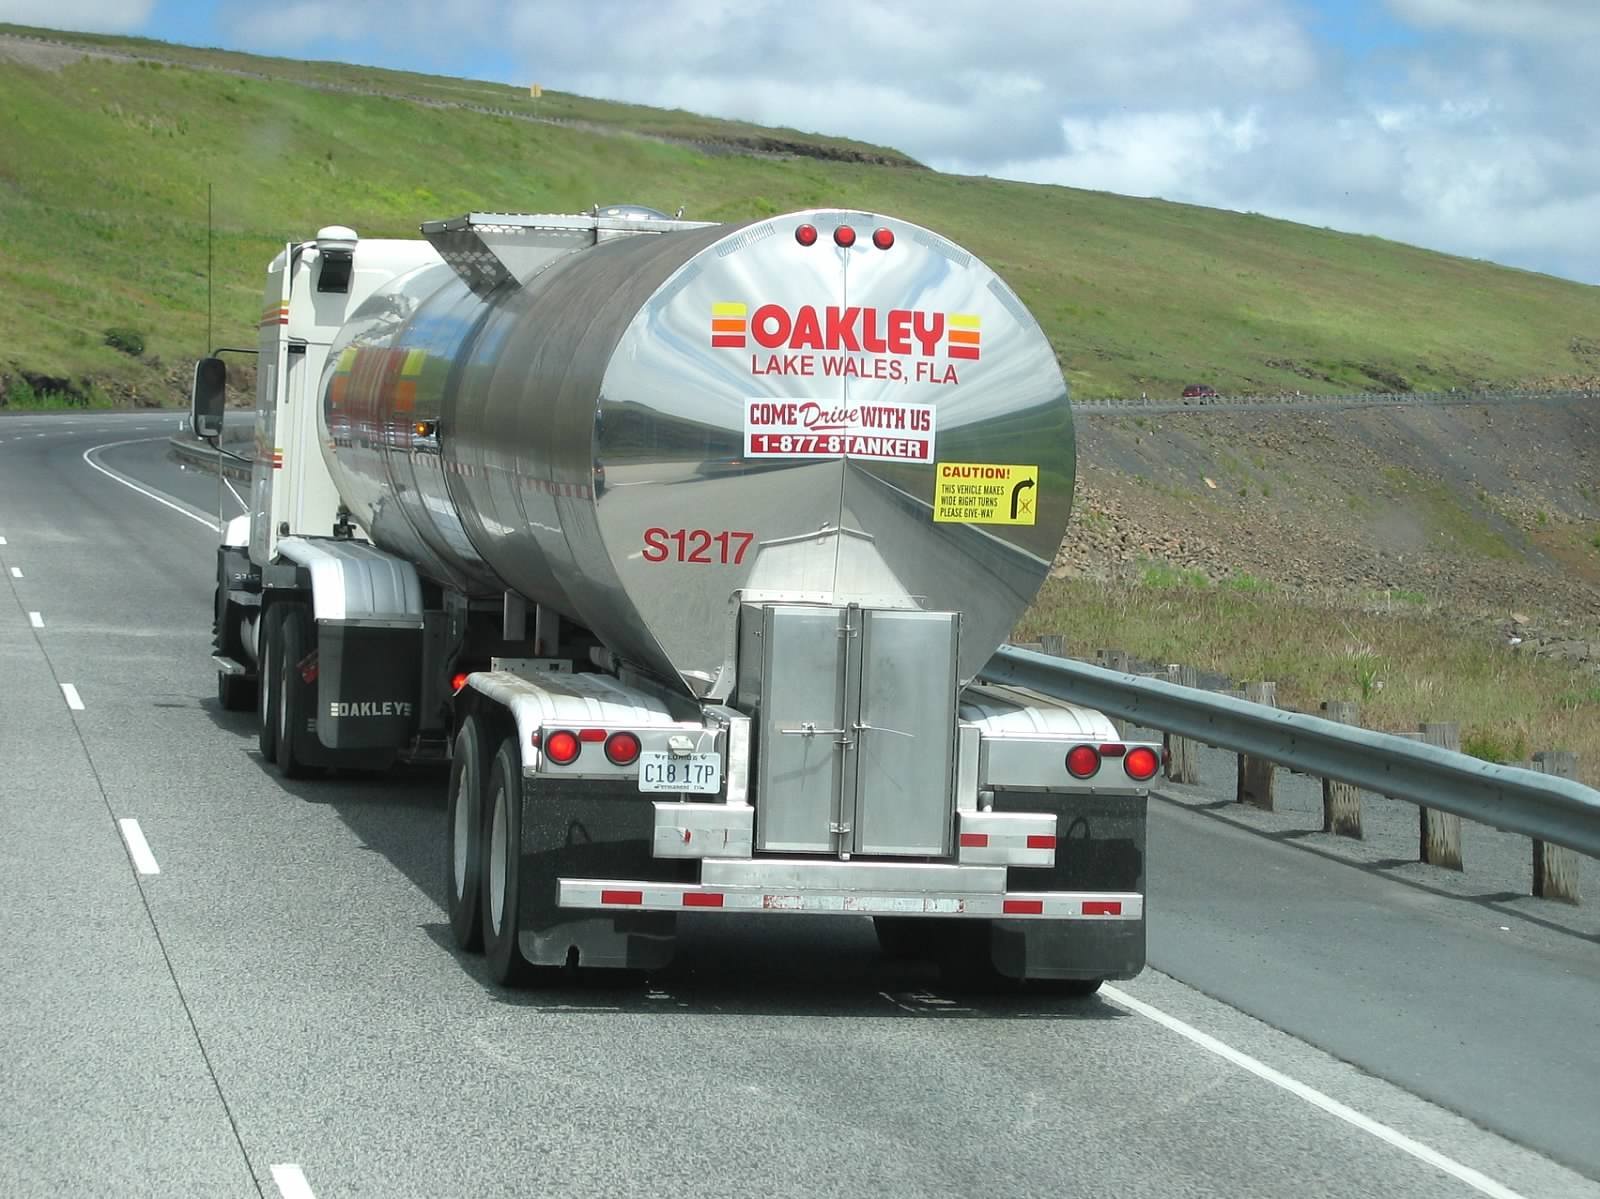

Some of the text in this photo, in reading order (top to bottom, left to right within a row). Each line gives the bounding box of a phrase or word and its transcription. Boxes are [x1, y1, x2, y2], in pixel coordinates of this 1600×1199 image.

[751, 304, 944, 356] OAKLEY
[752, 354, 959, 384] LAKE WALES, FLA
[750, 402, 931, 431] COME Drive WITH US
[758, 435, 921, 457] 1-877-8TANKER
[942, 466, 1010, 479] CAUTION!
[941, 484, 1005, 496] THIS VEHICLE MAKES
[940, 496, 998, 507] WIDE RIGHT TURNS
[940, 507, 993, 518] PLEASE GIVE-WAY
[642, 527, 754, 565] S1217
[339, 702, 403, 717] OAKLEY
[645, 763, 715, 784] C18 17P
